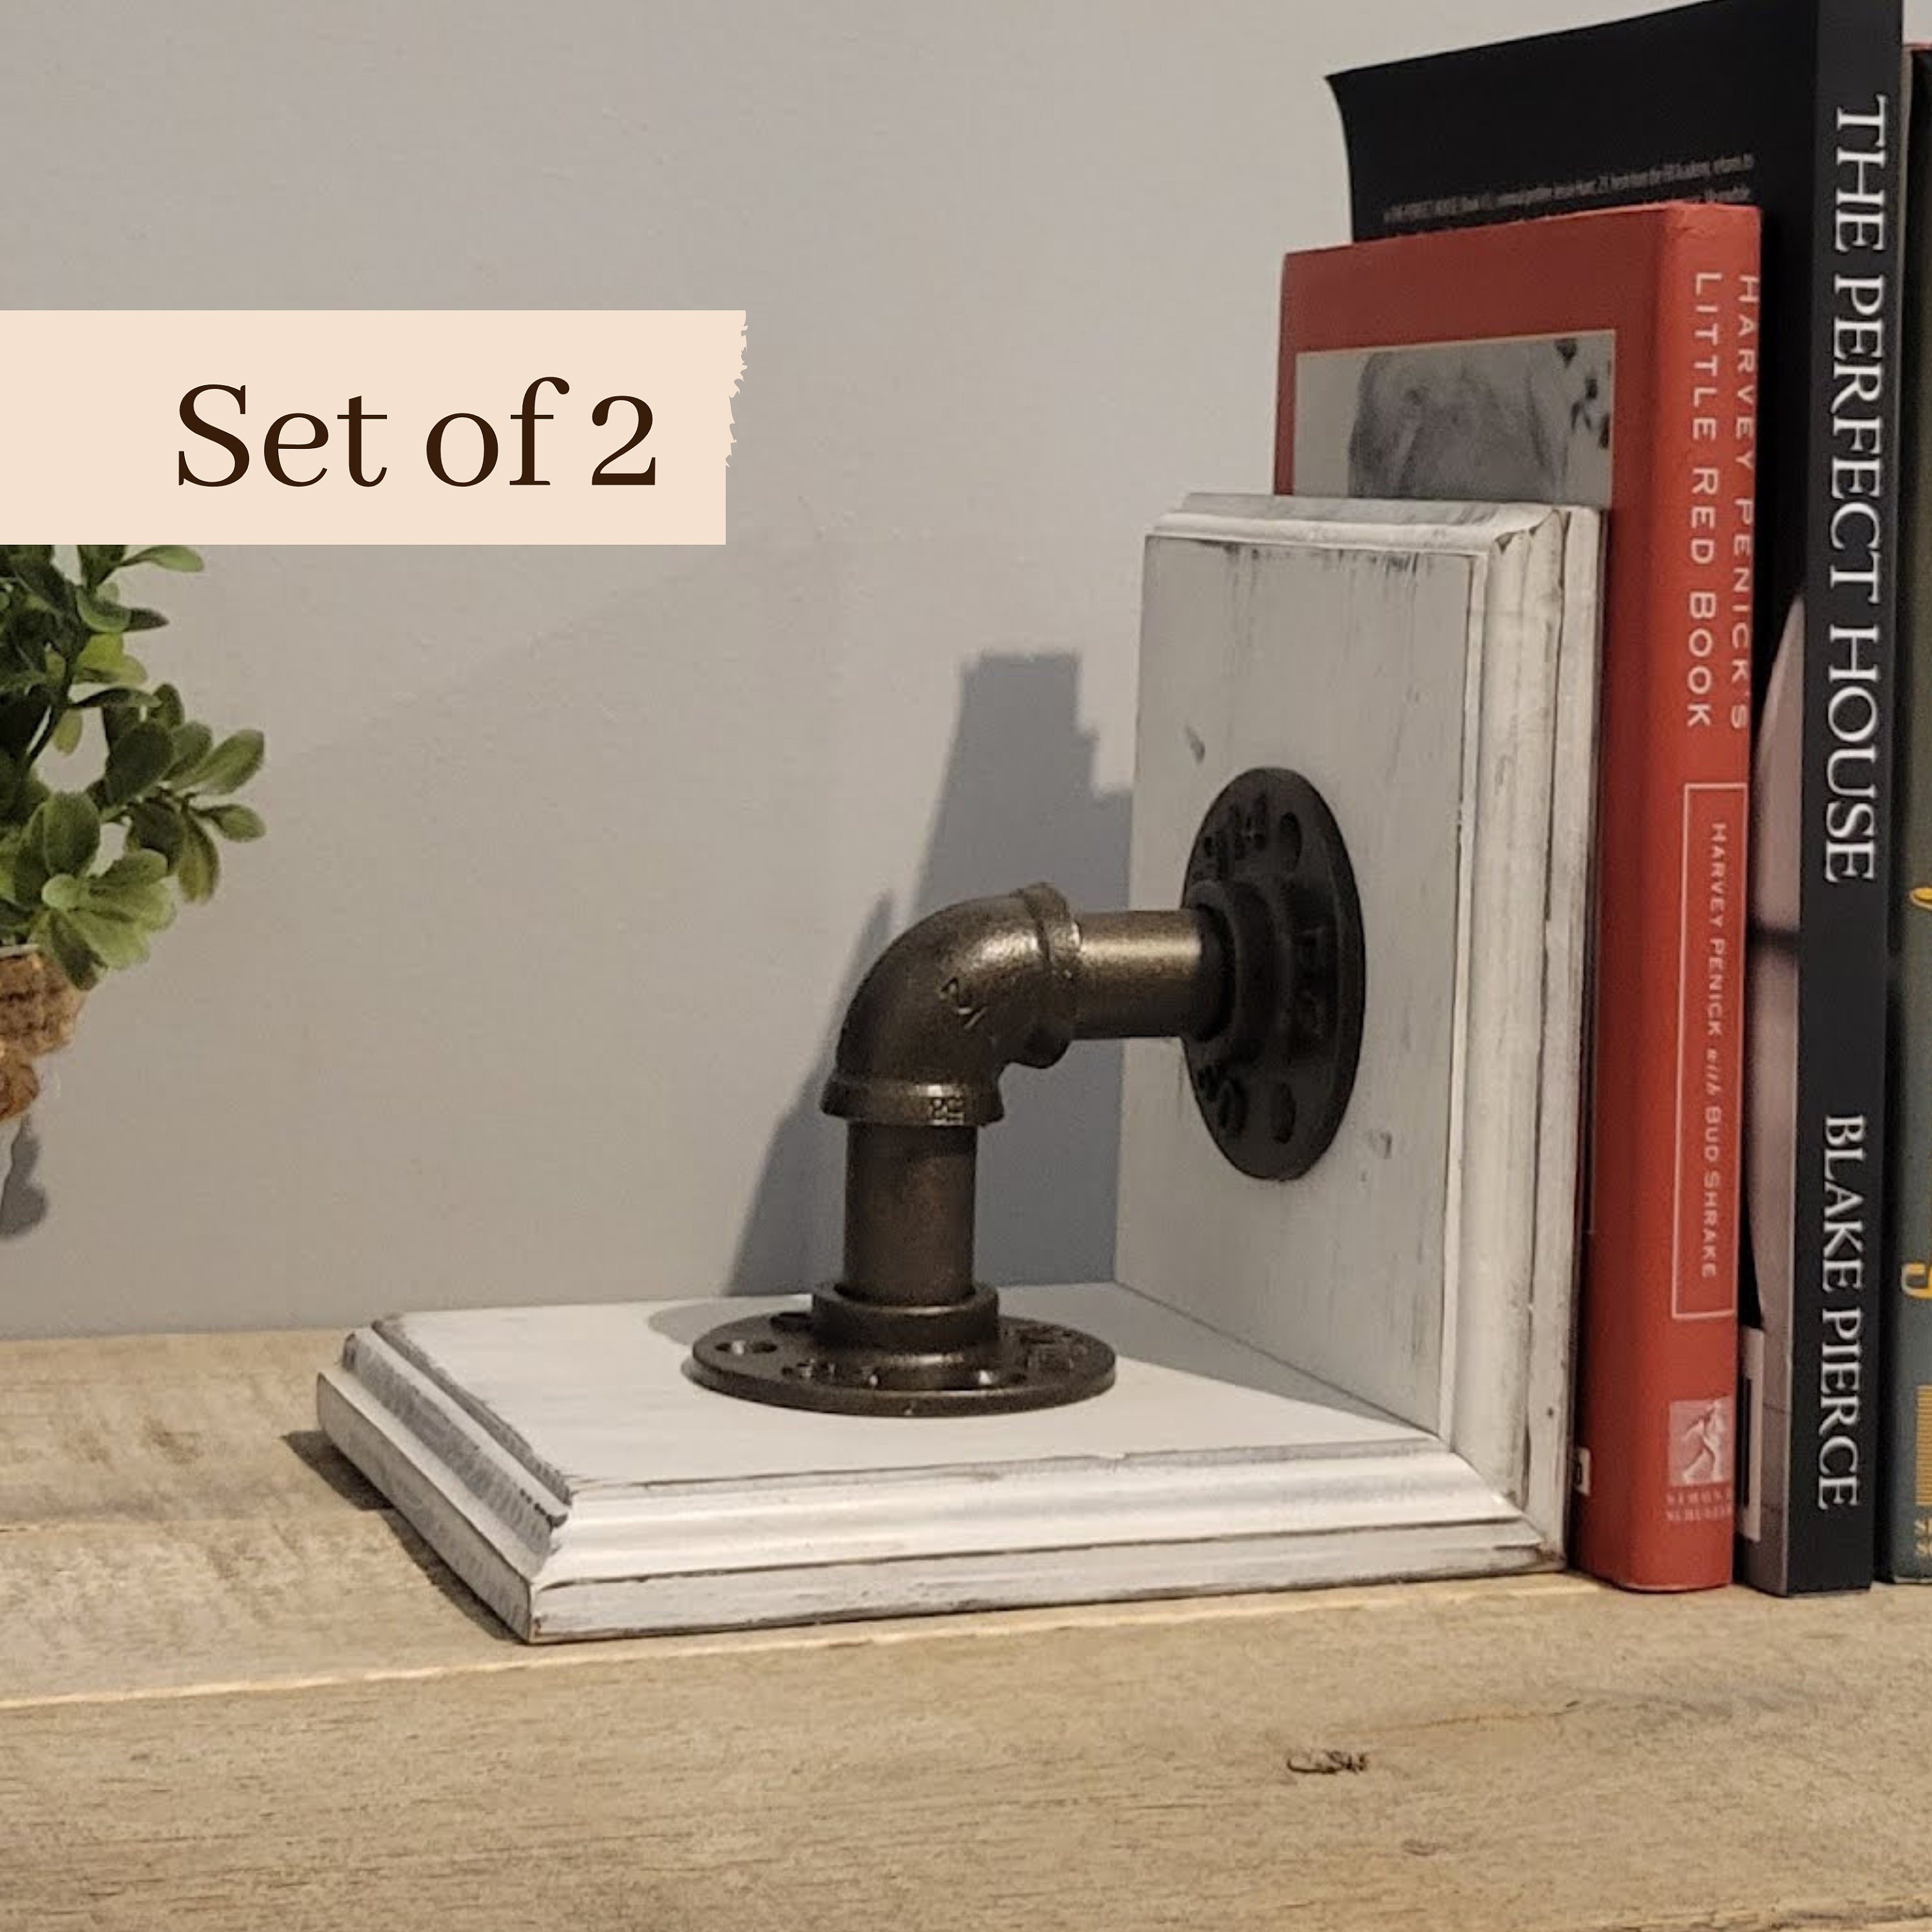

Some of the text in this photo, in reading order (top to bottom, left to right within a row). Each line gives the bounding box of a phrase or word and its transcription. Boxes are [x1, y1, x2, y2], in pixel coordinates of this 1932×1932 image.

[1686, 271, 1723, 728] LITTLE RED BOOK
[1730, 274, 1759, 730] HARVEY PENICK'S
[1824, 94, 1887, 884] THE PERFECT HOUSE
[1707, 938, 1727, 1037] PENICK
[1709, 822, 1728, 929] HARVEY
[1701, 1170, 1721, 1278] SHRAKE
[1703, 1104, 1723, 1164] BUD
[1817, 1115, 1866, 1511] BLAKE PIERCE
